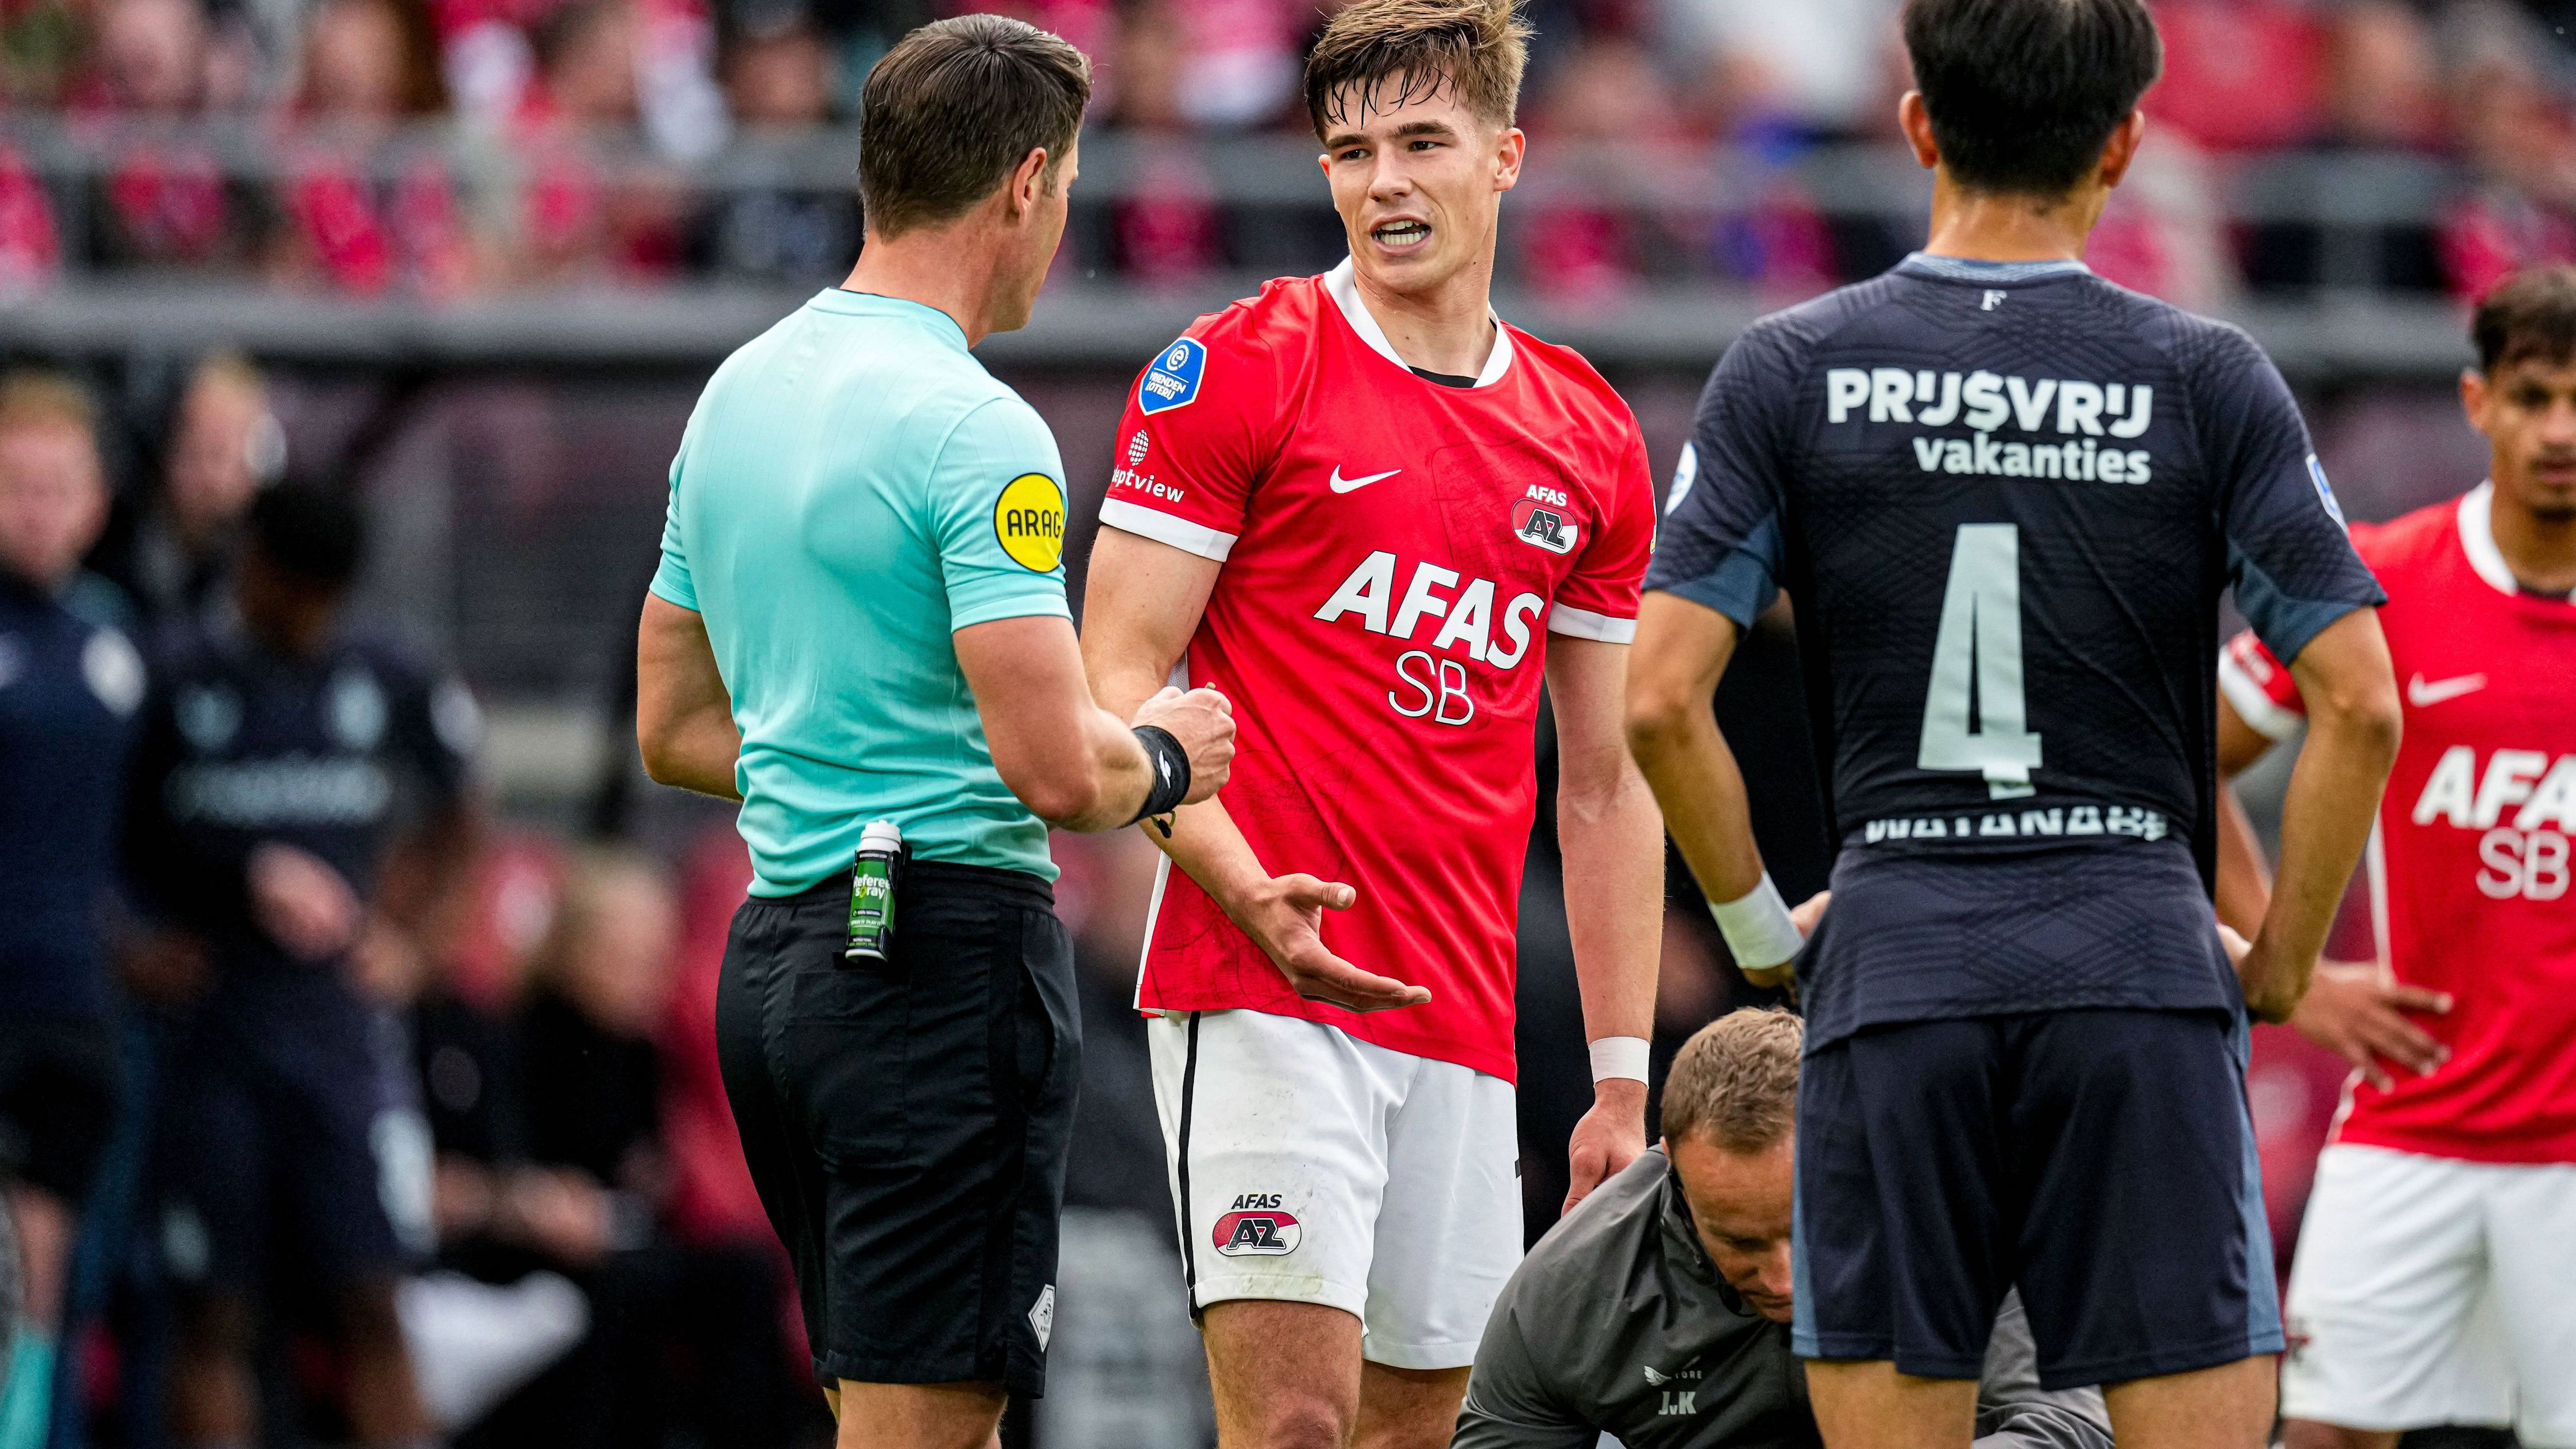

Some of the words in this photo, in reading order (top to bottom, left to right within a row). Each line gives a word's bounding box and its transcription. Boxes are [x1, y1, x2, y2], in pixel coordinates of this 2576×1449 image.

[1980, 289, 2007, 310] F
[1145, 381, 1176, 400] LOTERIJ
[1149, 371, 1186, 394] VRIENDEN
[1913, 431, 2152, 485] vakanties
[1526, 484, 1567, 506] AFAS
[1007, 509, 1061, 538] ARAG
[1522, 508, 1566, 550] AZ
[1313, 550, 1545, 670] AFAS
[1917, 523, 2043, 800] 4
[1388, 650, 1475, 726] SB
[2475, 826, 2571, 900] SB
[855, 886, 885, 900] spray
[1231, 1194, 1282, 1209] AFAS
[1226, 1217, 1287, 1250] AZ
[1658, 1391, 1697, 1415] JvK
